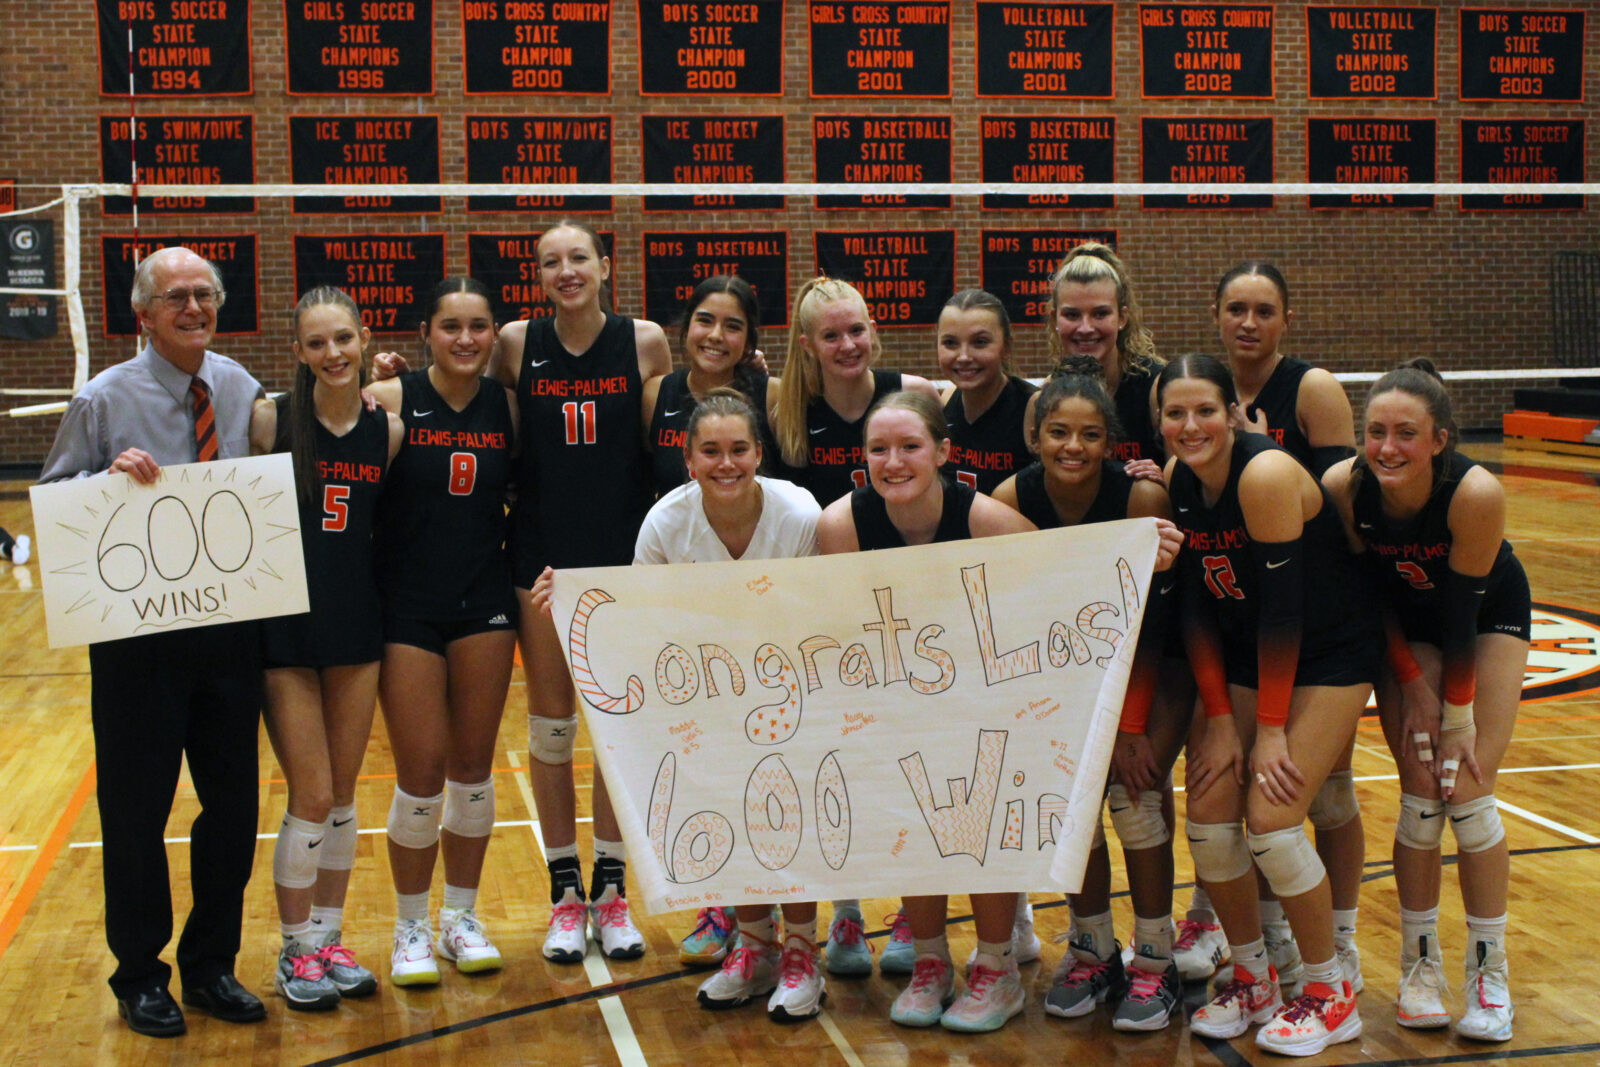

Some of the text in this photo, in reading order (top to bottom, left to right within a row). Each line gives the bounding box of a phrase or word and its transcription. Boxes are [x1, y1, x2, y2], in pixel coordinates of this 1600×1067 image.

[119, 0, 226, 20] BOYS SOCCER
[304, 2, 415, 20] GIRLS SOCCER
[466, 2, 607, 21] BOYS CROSS COUNTRY
[663, 4, 759, 22] BOYS SOCCER
[812, 5, 947, 24] GIRLS CROSS COUNTRY
[1004, 8, 1087, 26] VOLLEYBALL
[1143, 9, 1270, 28] GIRLS CROSS COUNTRY
[1330, 12, 1414, 29] VOLLEYBALL
[1480, 15, 1567, 32] BOYS SOCCER
[153, 24, 195, 43] STATE
[339, 25, 380, 43] STATE
[515, 25, 559, 43] STATE
[690, 26, 732, 45] STATE
[860, 28, 901, 46] STATE
[1025, 30, 1066, 48] STATE
[1187, 31, 1229, 48] STATE
[1353, 33, 1392, 50] STATE
[1506, 36, 1540, 53] STATE
[139, 48, 210, 66] CHAMPION
[322, 47, 399, 66] CHAMPIONS
[502, 47, 572, 65] CHAMPION
[678, 48, 745, 66] CHAMPION
[848, 50, 914, 68] CHAMPION
[1009, 51, 1082, 69] CHAMPIONS
[1175, 52, 1241, 70] CHAMPION
[1337, 54, 1408, 71] CHAMPIONS
[1490, 56, 1555, 74] CHAMPIONS
[153, 70, 200, 89] 1994
[339, 70, 384, 88] 1996
[512, 69, 563, 87] 2000
[687, 70, 736, 88] 2000
[858, 72, 903, 90] 2001
[1024, 73, 1067, 91] 2001
[1185, 73, 1232, 91] 2002
[1350, 75, 1396, 91] 2002
[1501, 78, 1543, 94] 2003
[163, 120, 242, 139] SWIM/DIVE
[317, 121, 411, 140] ICE HOCKEY
[471, 121, 607, 140] BOYS SWIM/DIVE
[667, 121, 758, 139] ICE HOCKEY
[817, 121, 949, 139] BOYS BASKETBALL
[984, 121, 1110, 139] BOYS BASKETBALL
[1168, 124, 1248, 141] VOLLEYBALL
[1334, 124, 1410, 141] VOLLEYBALL
[1478, 126, 1568, 142] GIRLS SOCCER
[156, 144, 199, 162] STATE
[344, 144, 386, 162] STATE
[518, 144, 562, 162] STATE
[693, 144, 734, 161] STATE
[861, 143, 905, 160] STATE
[1029, 143, 1068, 160] STATE
[1187, 145, 1228, 161] STATE
[1352, 145, 1392, 161] STATE
[1505, 147, 1542, 162] STATE
[136, 167, 220, 184] CHAMPIONS
[326, 166, 408, 185] CHAMPIONS
[503, 166, 577, 184] CHAMPION
[675, 165, 753, 184] CHAMPIONS
[845, 164, 922, 182] CHAMPIONS
[1013, 165, 1084, 182] CHAMPIONS
[1171, 166, 1246, 183] CHAMPIONS
[1337, 166, 1408, 183] CHAMPIONS
[1489, 167, 1557, 183] CHAMPIONS
[324, 241, 416, 260] VOLLEYBALL
[650, 241, 781, 256] BOYS BASKETBALL
[843, 236, 928, 255] VOLLEYBALL
[988, 237, 1020, 252] BOYS
[347, 264, 395, 282] STATE
[693, 263, 739, 278] STATE
[864, 259, 909, 276] STATE
[848, 280, 926, 298] HAMPIONS
[361, 308, 397, 327] 017
[531, 376, 627, 396] LEWIS-PALMER
[562, 400, 597, 445] 11
[409, 427, 505, 449] LEWIS-PALMER
[448, 452, 477, 496] 8
[322, 485, 350, 532] 5
[97, 490, 253, 592] 600
[132, 583, 228, 620] WINS!
[569, 587, 956, 745] Congrats
[647, 750, 850, 884] 600
